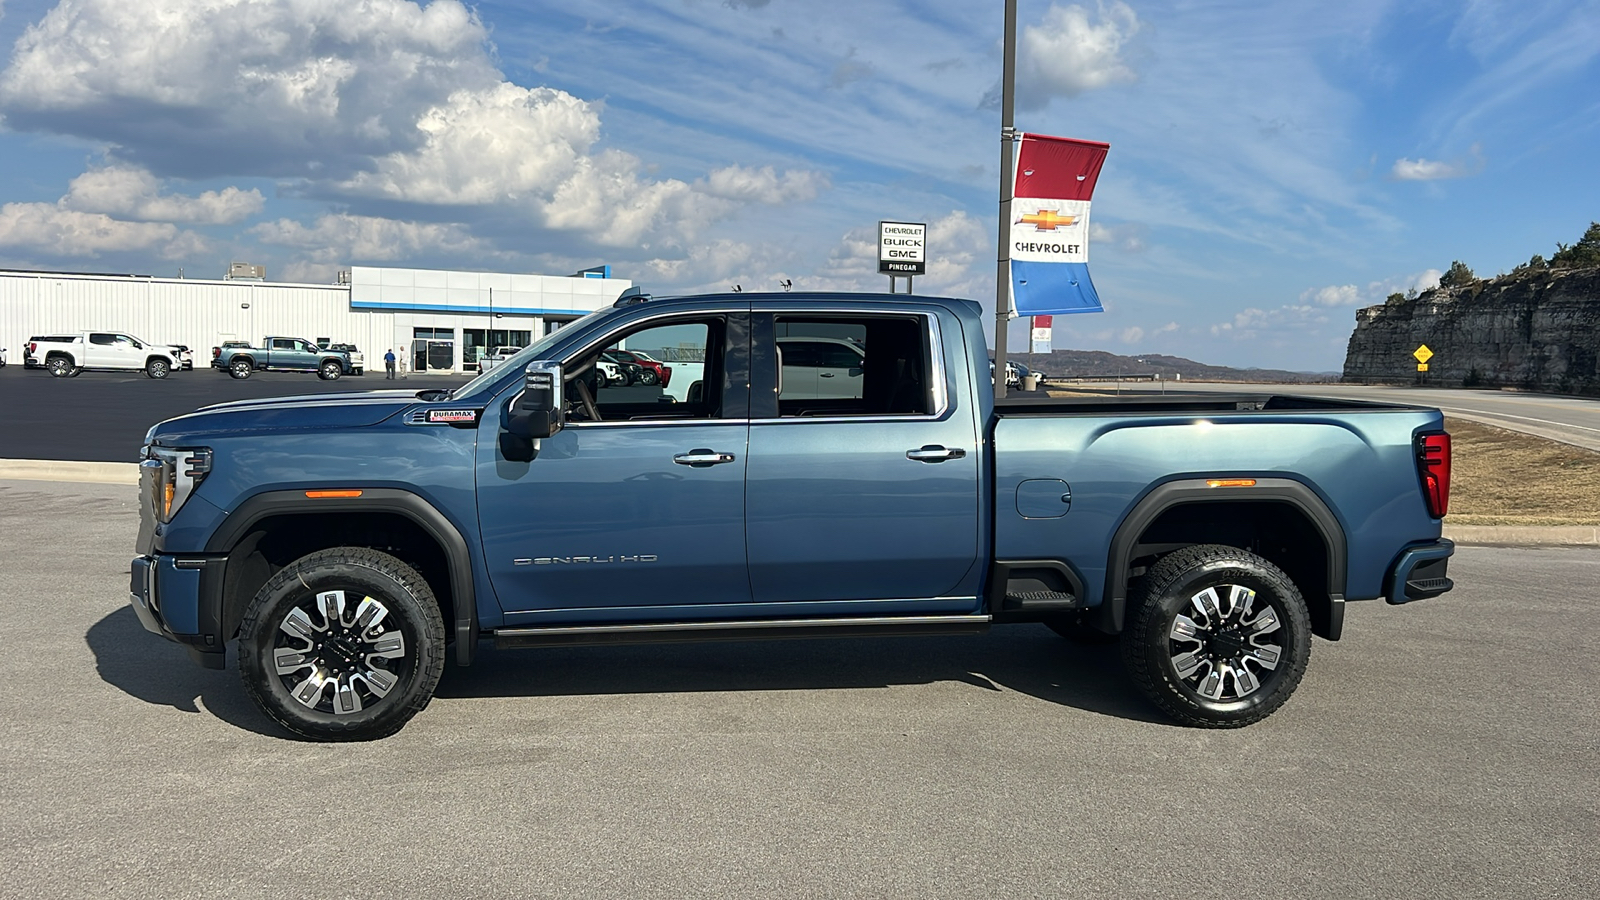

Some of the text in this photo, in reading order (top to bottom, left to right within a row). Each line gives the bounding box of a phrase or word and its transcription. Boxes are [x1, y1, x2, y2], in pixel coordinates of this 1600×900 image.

[884, 227, 922, 235] CHEVROLET
[883, 238, 922, 247] BUICK
[1015, 242, 1080, 254] CHEVROLET
[888, 250, 917, 258] GMC
[888, 263, 917, 271] PINEGAR
[513, 554, 658, 566] DENALI HD
